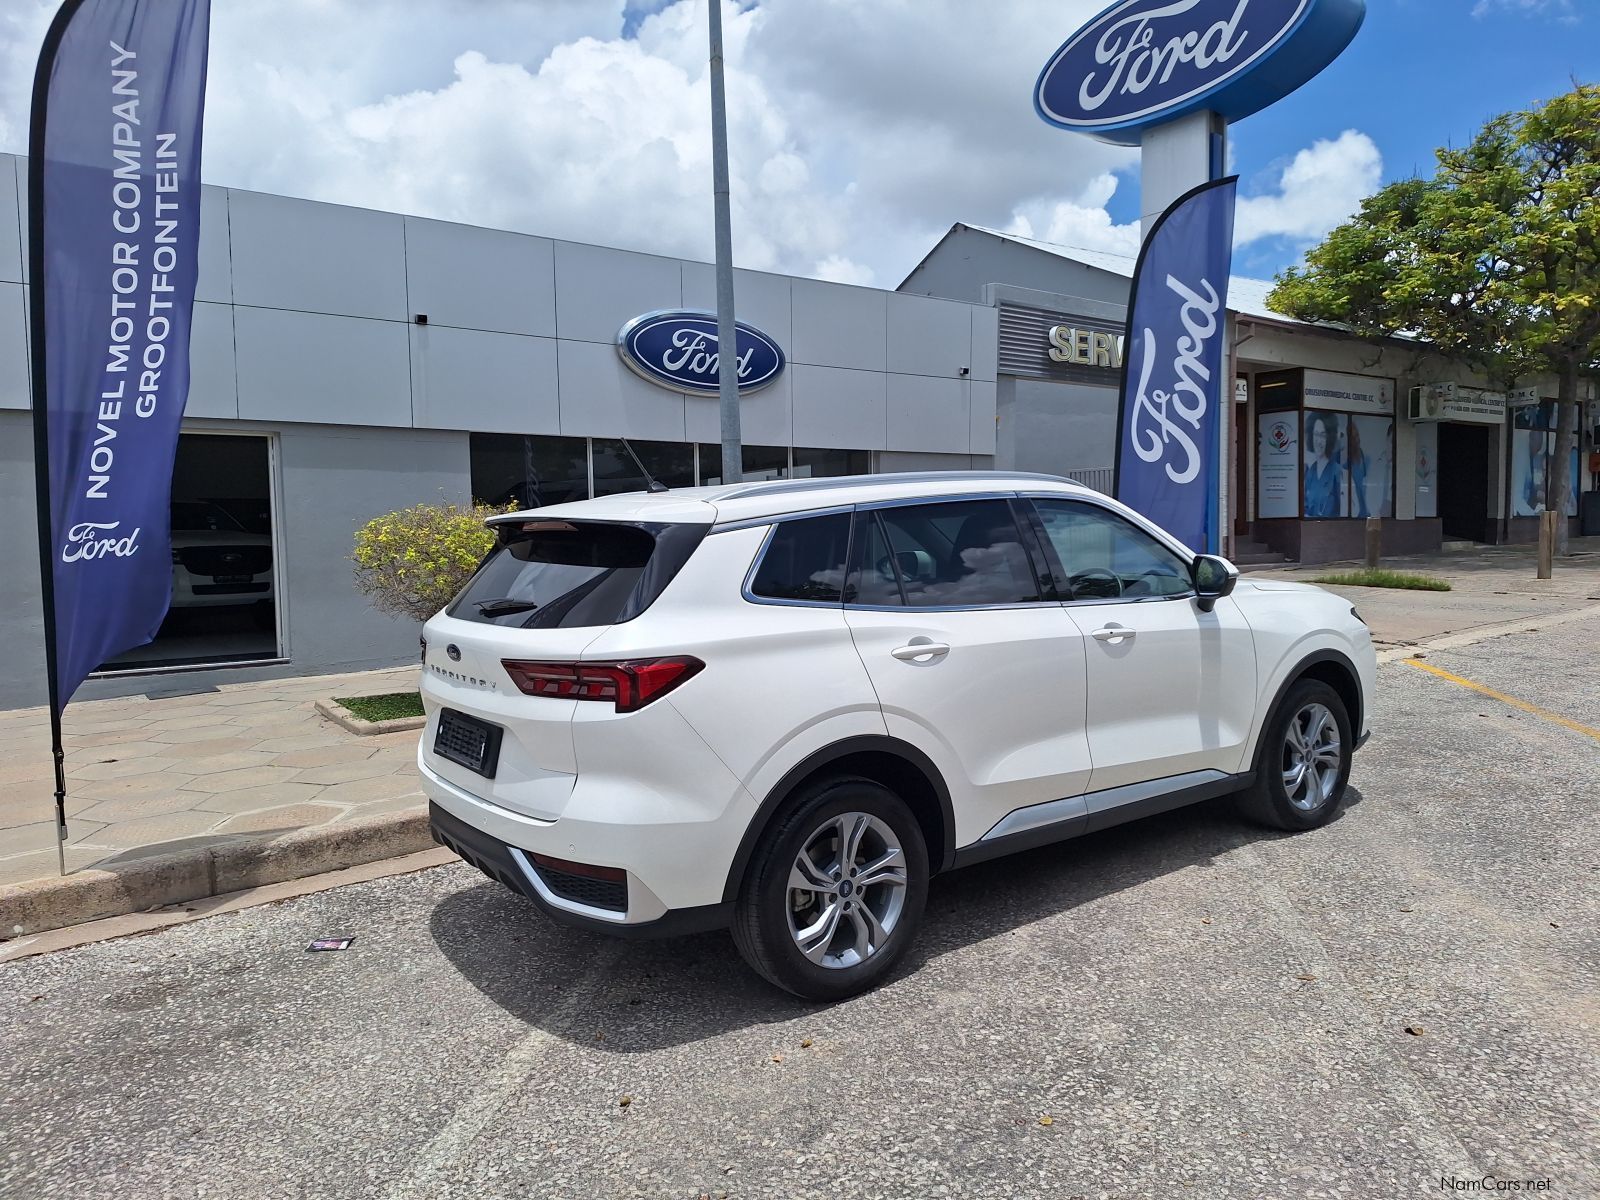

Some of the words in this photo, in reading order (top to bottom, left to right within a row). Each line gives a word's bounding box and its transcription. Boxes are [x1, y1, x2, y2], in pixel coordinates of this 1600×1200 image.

[1078, 0, 1248, 111] Ford
[109, 39, 142, 234] COMPANY
[105, 242, 140, 373] MOTOR
[135, 133, 179, 418] GROOTFONTEIN
[86, 380, 125, 499] NOVEL
[1131, 273, 1220, 484] Ford
[62, 520, 141, 563] Ford
